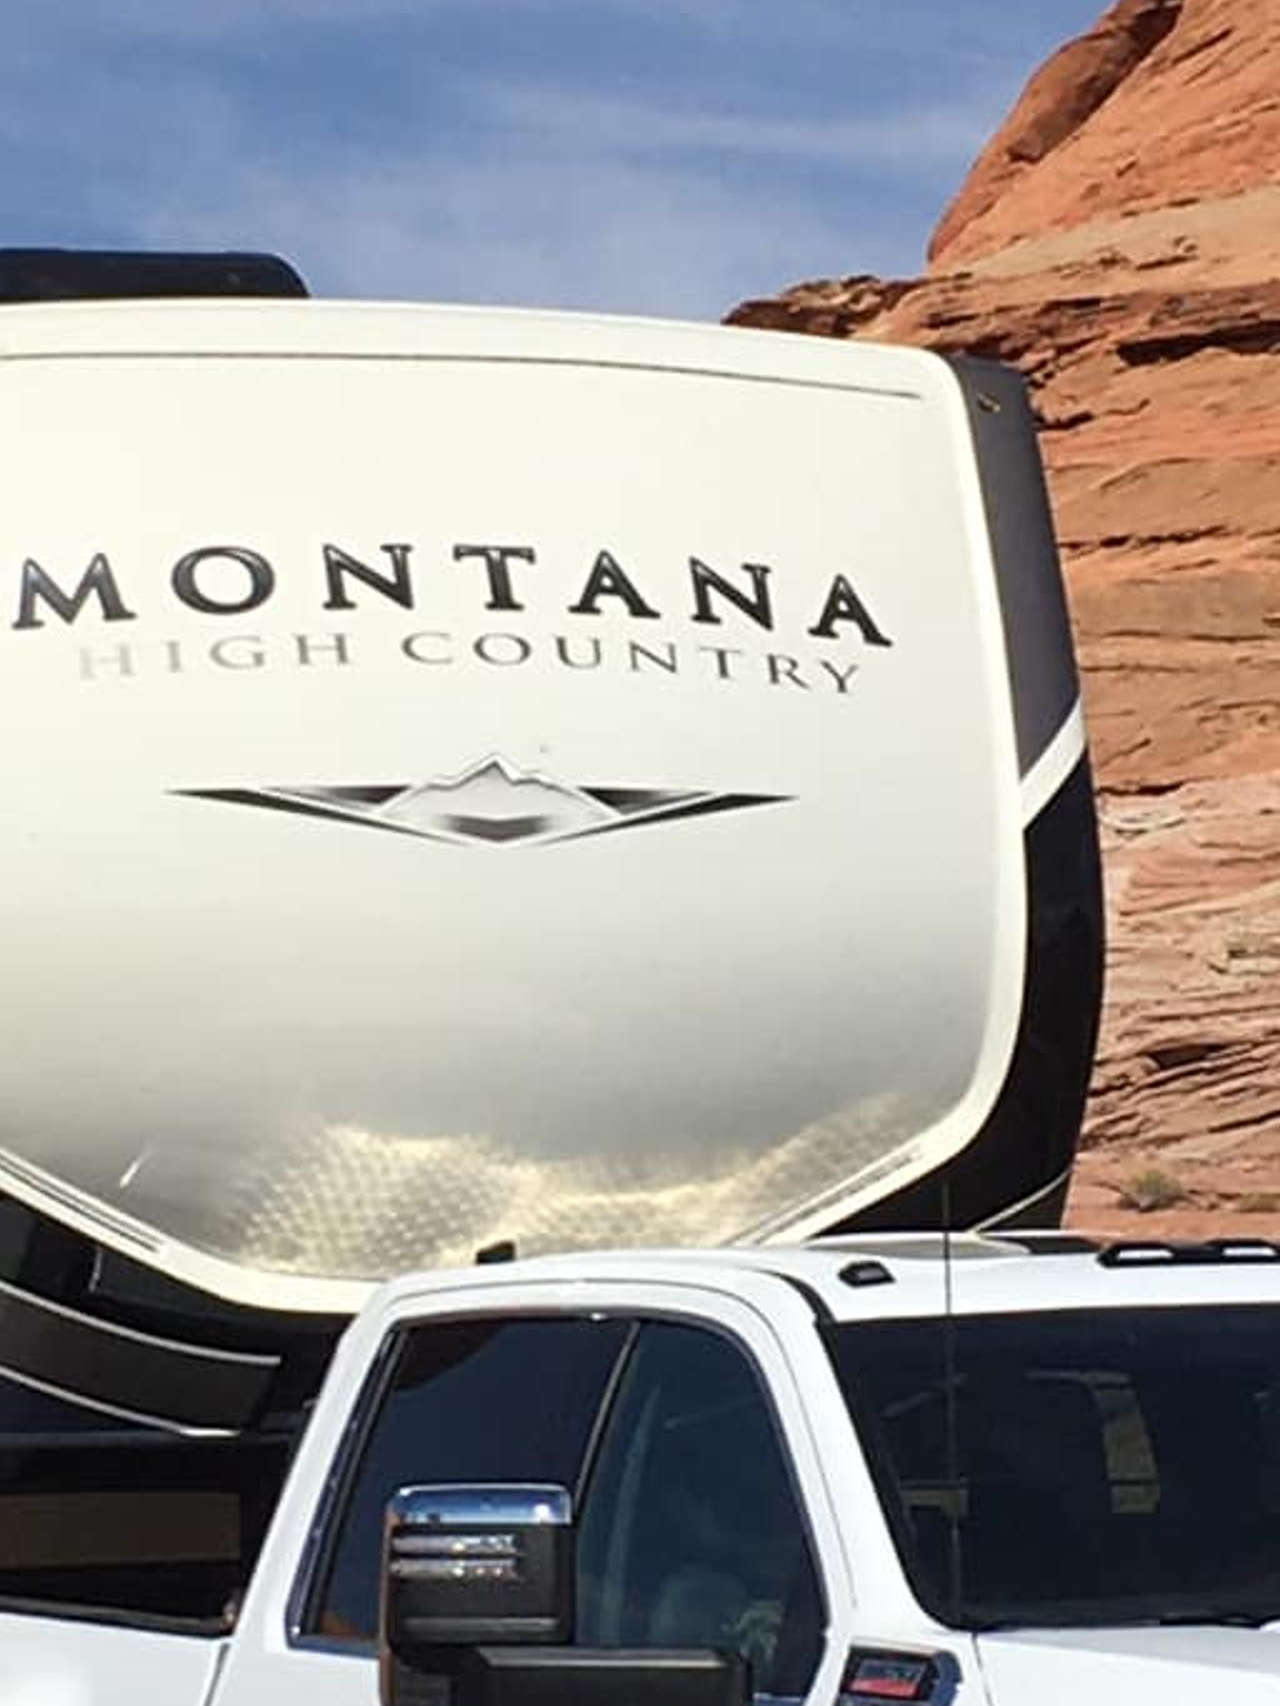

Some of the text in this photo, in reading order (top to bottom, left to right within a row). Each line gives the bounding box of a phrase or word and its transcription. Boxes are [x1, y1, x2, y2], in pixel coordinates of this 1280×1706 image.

[11, 544, 893, 647] MONTANA
[79, 632, 861, 693] HIGH COUNTRY
